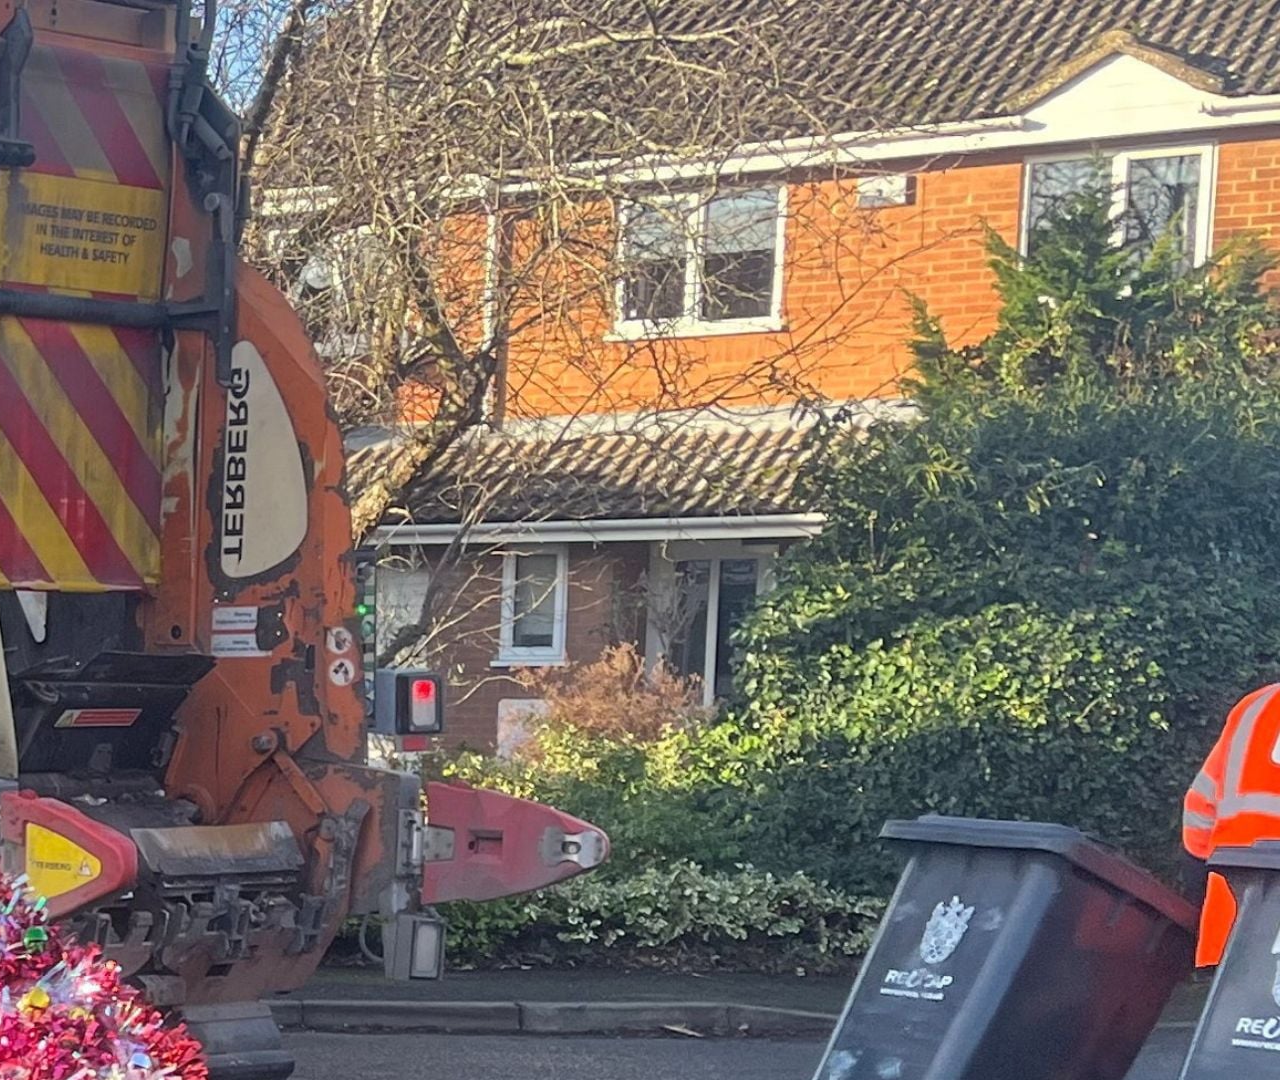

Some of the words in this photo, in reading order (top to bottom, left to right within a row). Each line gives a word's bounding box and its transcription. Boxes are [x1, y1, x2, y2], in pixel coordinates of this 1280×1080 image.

[60, 207, 85, 221] MAY
[86, 211, 100, 223] BE
[102, 212, 158, 231] RECORDED
[36, 223, 48, 235] IN
[50, 224, 72, 239] THE
[72, 227, 120, 244] INTEREST
[122, 233, 137, 247] OF
[40, 242, 80, 259] HEALTH
[81, 247, 90, 260] &
[92, 248, 131, 264] SAFETY
